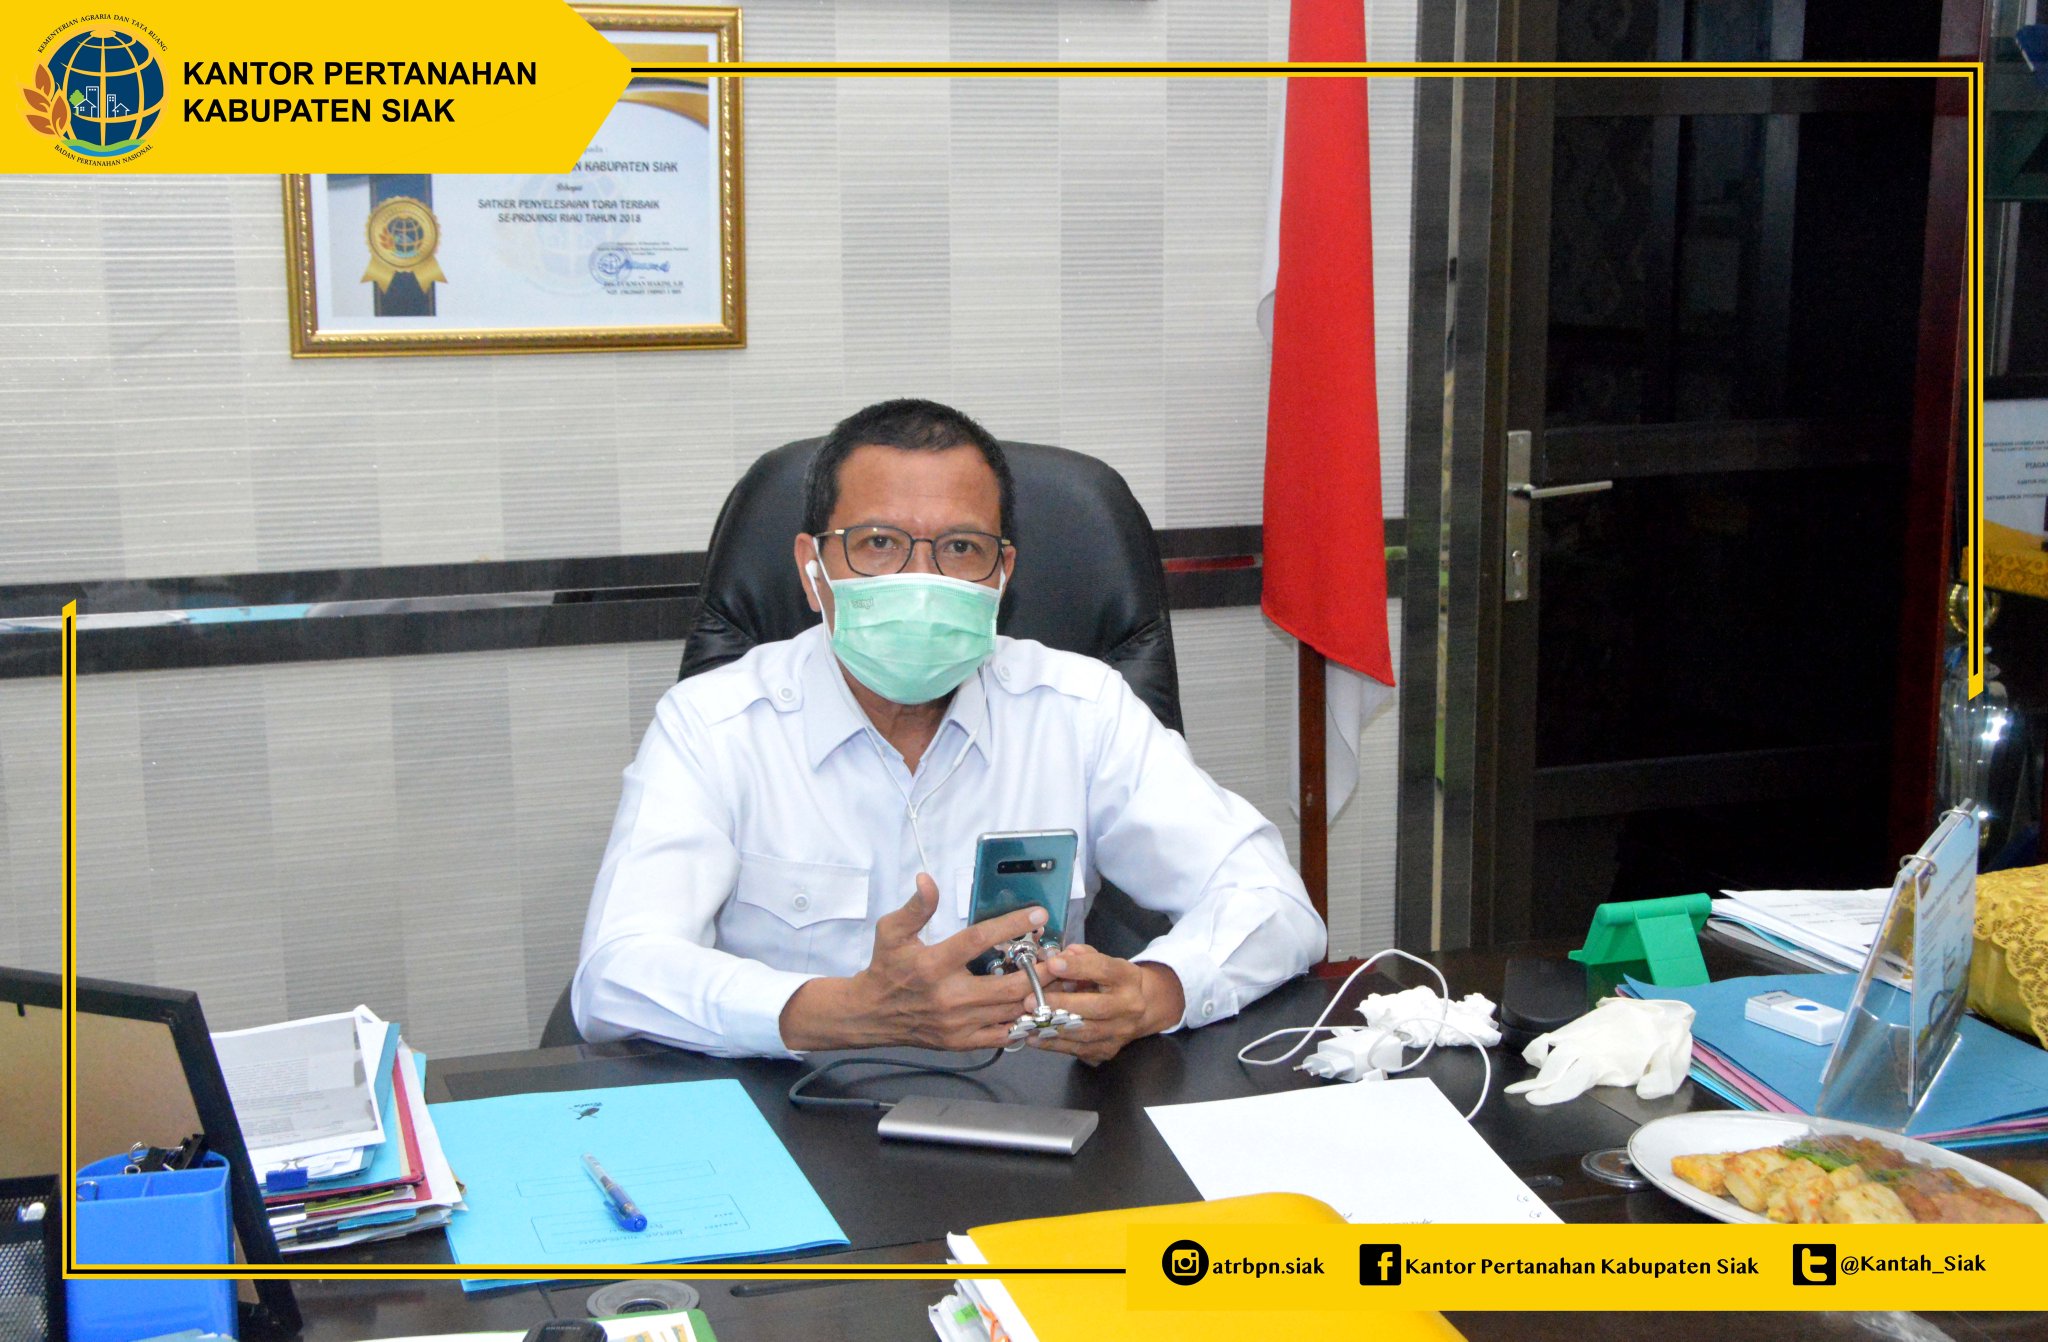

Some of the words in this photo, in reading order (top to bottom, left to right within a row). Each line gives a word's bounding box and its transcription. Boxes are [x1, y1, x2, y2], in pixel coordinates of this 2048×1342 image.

[584, 161, 650, 172] KABUPATEN
[653, 161, 678, 172] SIAK
[478, 199, 516, 209] SATKER
[592, 200, 618, 210] TORA
[620, 200, 660, 209] TERBAIK
[560, 213, 583, 223] RIAU
[585, 213, 617, 223] TAHUN
